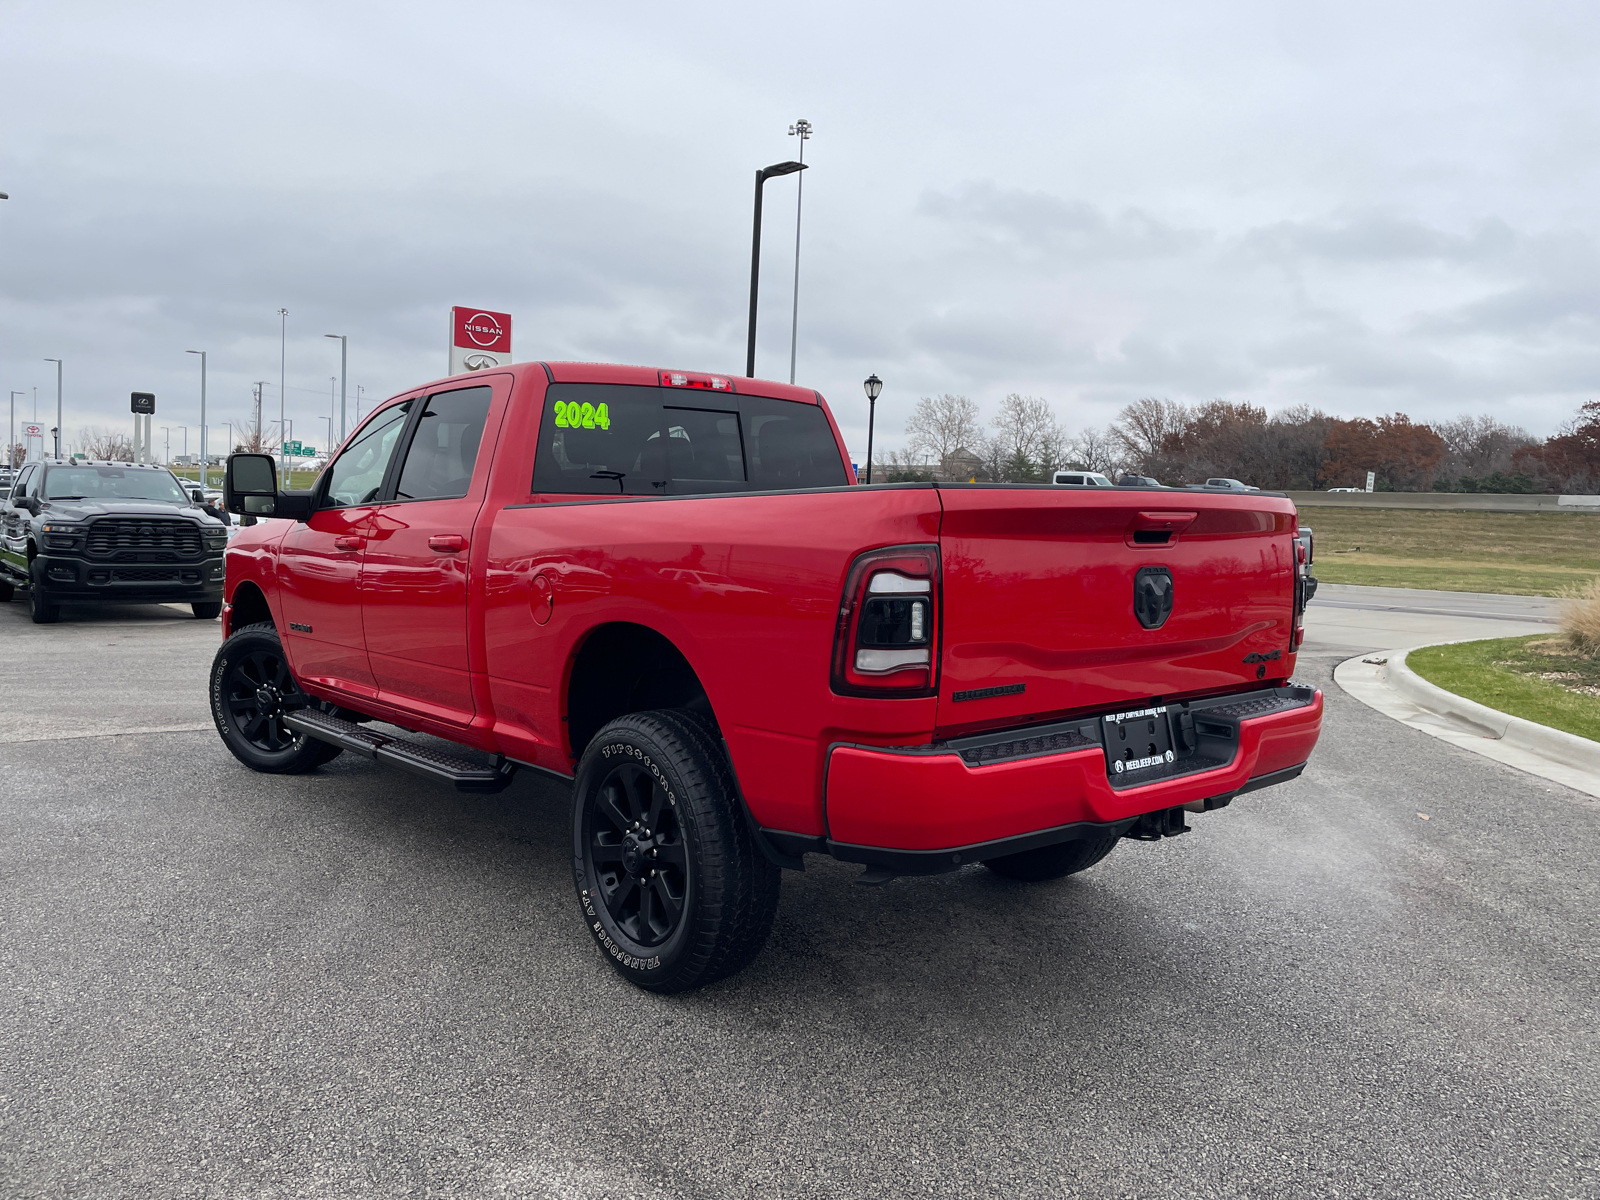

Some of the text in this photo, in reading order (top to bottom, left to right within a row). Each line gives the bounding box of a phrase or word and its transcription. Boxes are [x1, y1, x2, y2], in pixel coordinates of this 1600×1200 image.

[464, 323, 503, 335] NISSAN
[554, 400, 610, 430] 2024
[1105, 714, 1116, 722] REED
[1116, 712, 1125, 720] JEEP
[1126, 709, 1144, 719] CHRYSLER
[1145, 707, 1157, 715] DODGE
[1126, 754, 1164, 771] REEDJEEP.COM
[593, 921, 661, 970] TRANSFORCE
